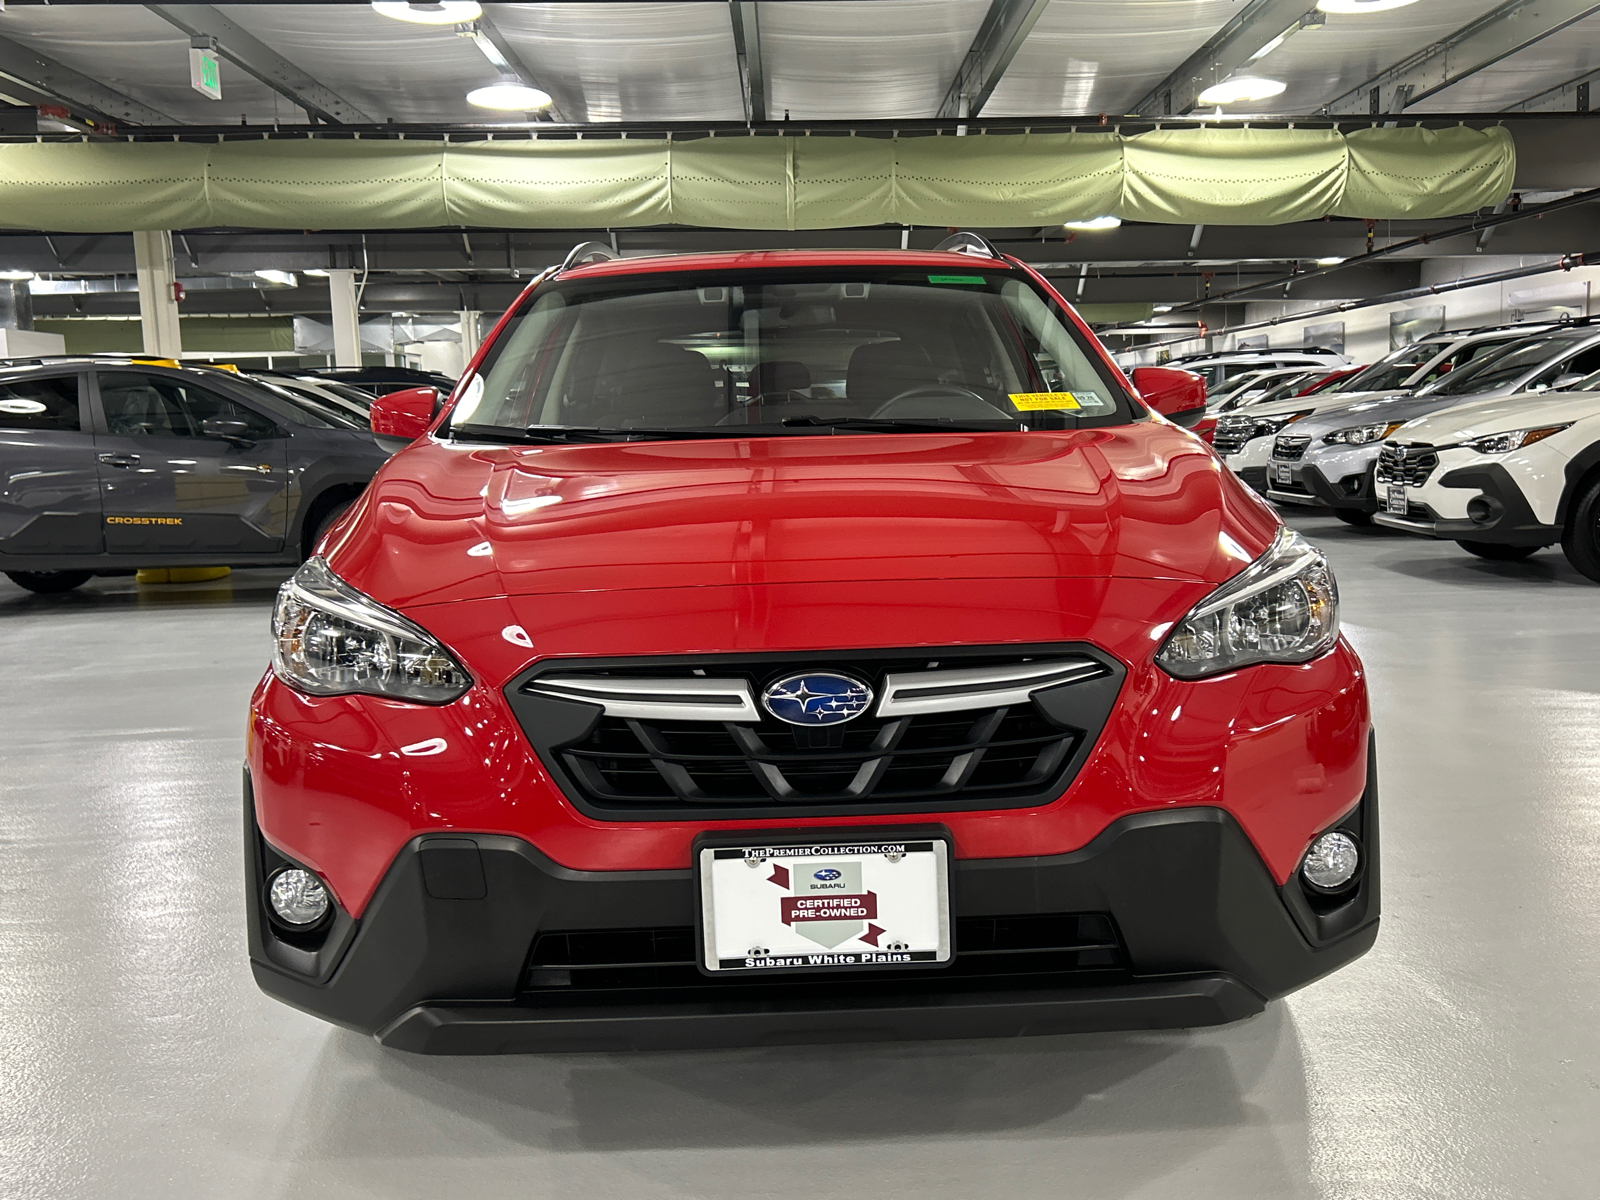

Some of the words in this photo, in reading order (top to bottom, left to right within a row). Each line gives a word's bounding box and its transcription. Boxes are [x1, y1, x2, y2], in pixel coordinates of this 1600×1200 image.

[106, 516, 183, 526] CROSSTREK
[797, 898, 861, 909] CERTIFIED
[791, 908, 867, 918] PRE-OWNED
[745, 957, 802, 968] Subaru
[808, 954, 855, 965] White
[861, 952, 912, 963] Plains
